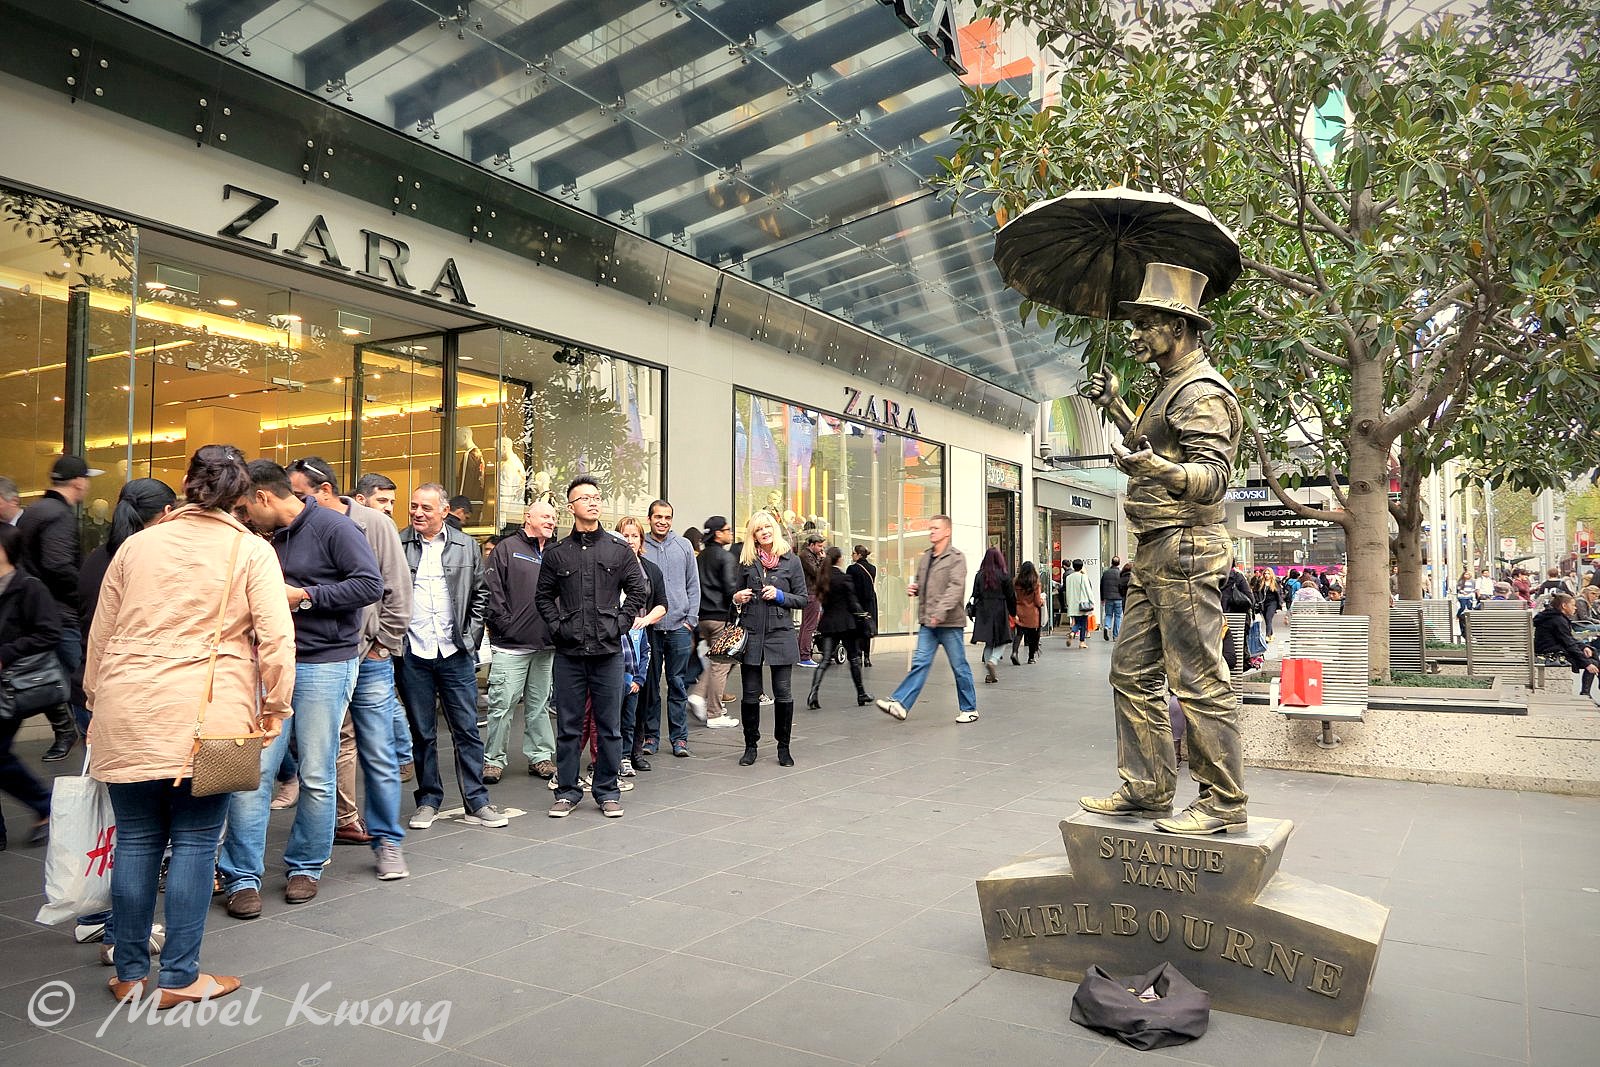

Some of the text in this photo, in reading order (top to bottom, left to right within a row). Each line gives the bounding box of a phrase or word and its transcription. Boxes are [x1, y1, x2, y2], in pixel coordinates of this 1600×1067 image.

[217, 183, 477, 308] ZARA
[843, 386, 921, 434] ZARA
[1100, 835, 1224, 873] STATUE
[1123, 861, 1198, 895] MAN
[996, 902, 1344, 998] MELBOURNE
